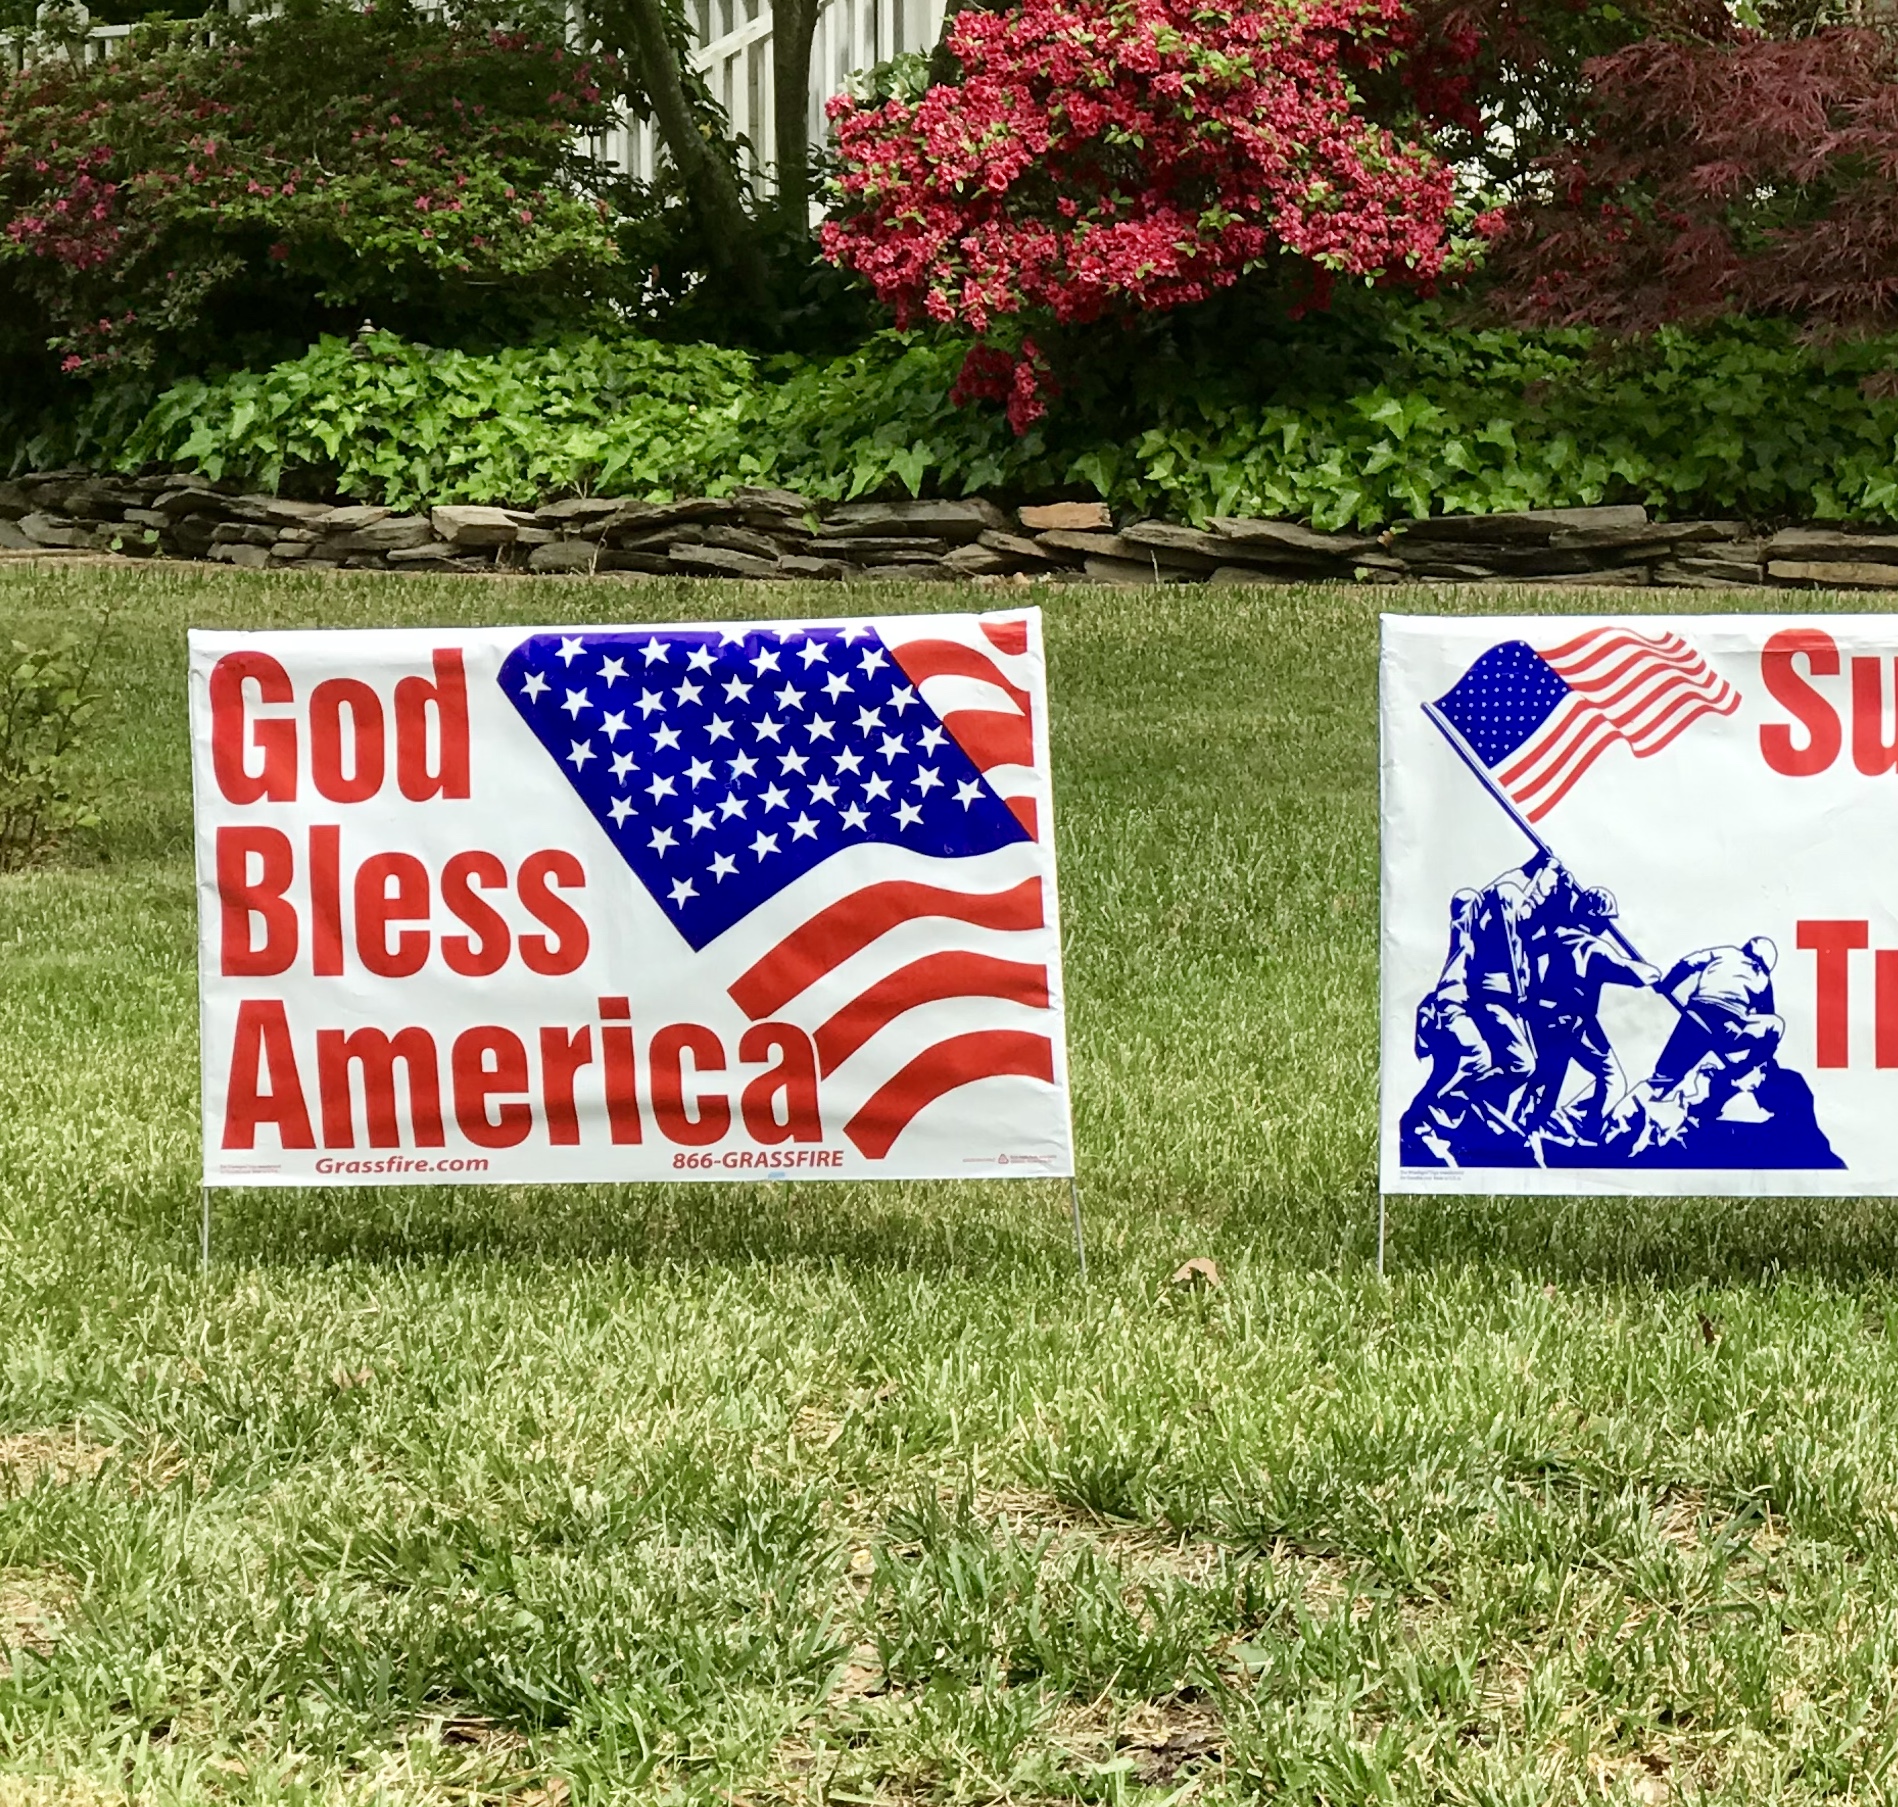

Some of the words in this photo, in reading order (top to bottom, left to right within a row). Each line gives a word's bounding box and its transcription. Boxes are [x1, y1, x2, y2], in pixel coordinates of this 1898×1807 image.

[209, 647, 471, 806] God
[216, 824, 590, 979] Bless
[222, 996, 822, 1150] America
[315, 1156, 489, 1175] Grassfire.com
[672, 1149, 845, 1170] 866-GRASSFIRE
